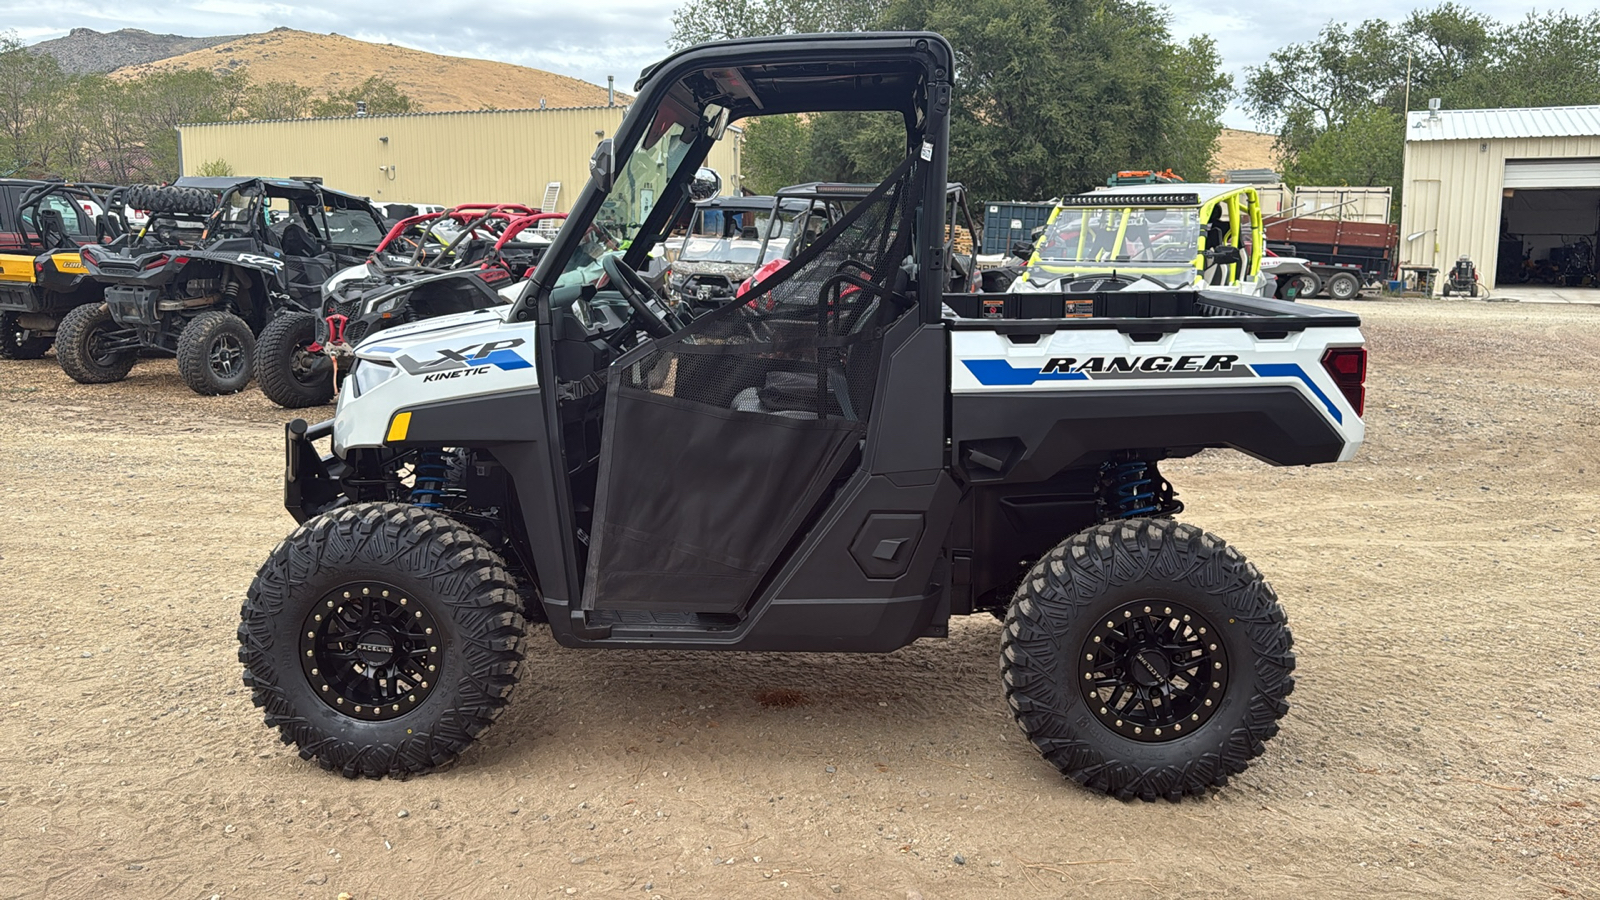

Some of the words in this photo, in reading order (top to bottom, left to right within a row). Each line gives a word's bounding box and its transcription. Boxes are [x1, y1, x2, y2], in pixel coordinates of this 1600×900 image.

[237, 253, 285, 270] RZR
[269, 290, 290, 299] XP
[1039, 354, 1240, 374] RANGER
[423, 366, 491, 383] KINETIC
[357, 643, 394, 653] RACELINE
[1136, 653, 1164, 683] RACELINE
